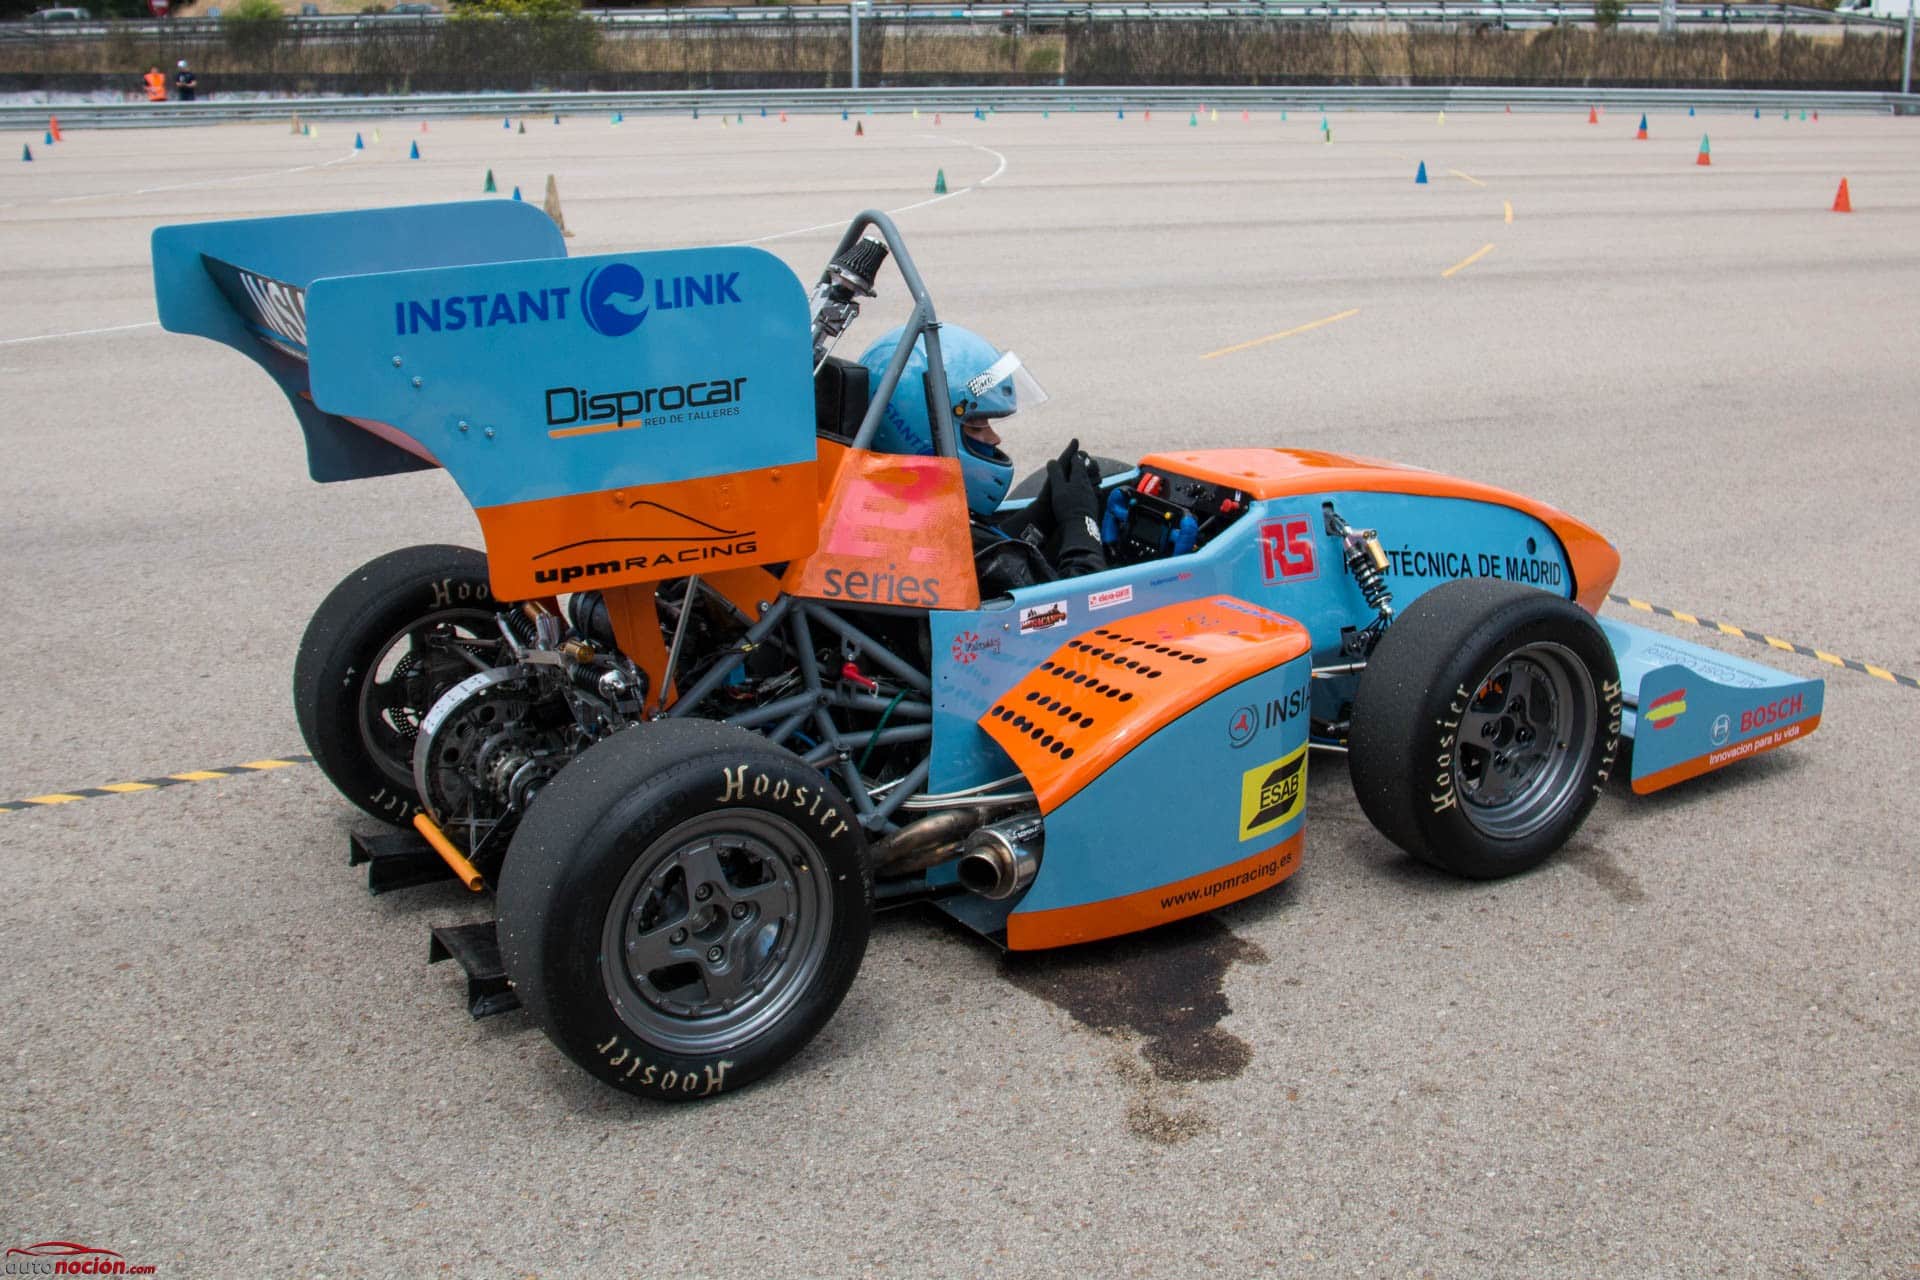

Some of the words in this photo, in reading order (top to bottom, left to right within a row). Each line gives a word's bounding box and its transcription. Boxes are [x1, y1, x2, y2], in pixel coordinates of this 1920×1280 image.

[395, 287, 571, 336] INSTANT
[655, 271, 743, 311] LINK
[545, 377, 748, 428] Disprocar
[645, 416, 666, 426] RED
[670, 414, 684, 424] DE
[688, 406, 740, 421] TALLERES
[823, 563, 940, 606] series
[1478, 554, 1501, 579] DE
[1507, 556, 1561, 586] MADRID
[1741, 692, 1804, 733] BOSCH
[1430, 683, 1470, 814] Hoosier
[1754, 735, 1773, 752] para
[1774, 732, 1782, 743] tu
[1784, 725, 1800, 738] vida
[716, 764, 849, 838] Hoosier
[1260, 773, 1299, 810] ESAB
[1160, 852, 1293, 910] www.upmracing.es
[597, 1035, 734, 1096] Hoosier
